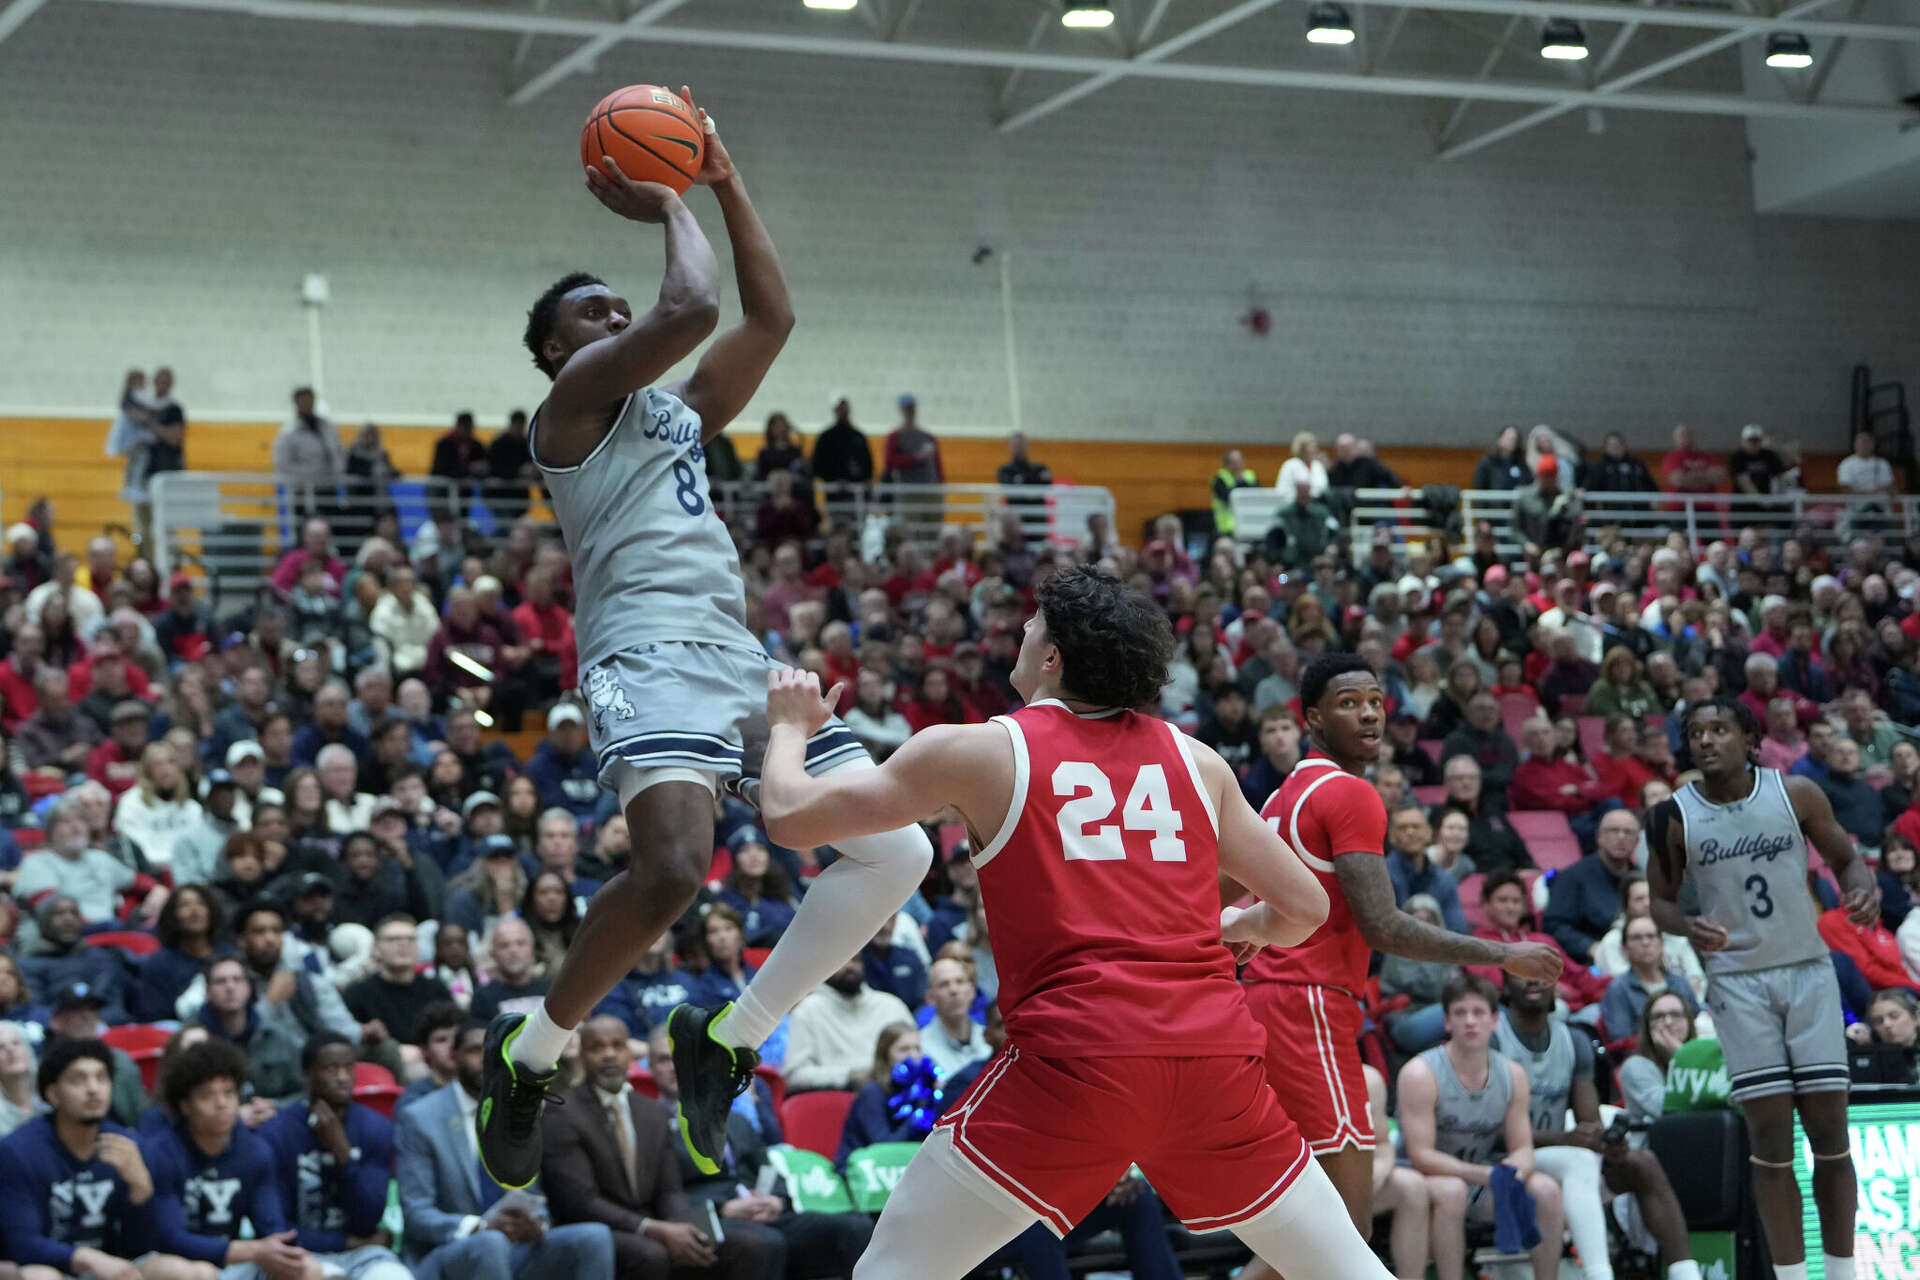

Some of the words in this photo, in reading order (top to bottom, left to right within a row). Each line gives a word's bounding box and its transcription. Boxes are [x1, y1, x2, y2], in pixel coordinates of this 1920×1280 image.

[672, 459, 705, 517] 8
[1051, 760, 1187, 862] 24
[1699, 832, 1793, 866] Bulldogs
[1745, 874, 1774, 919] 3
[858, 1159, 908, 1191] Iv
